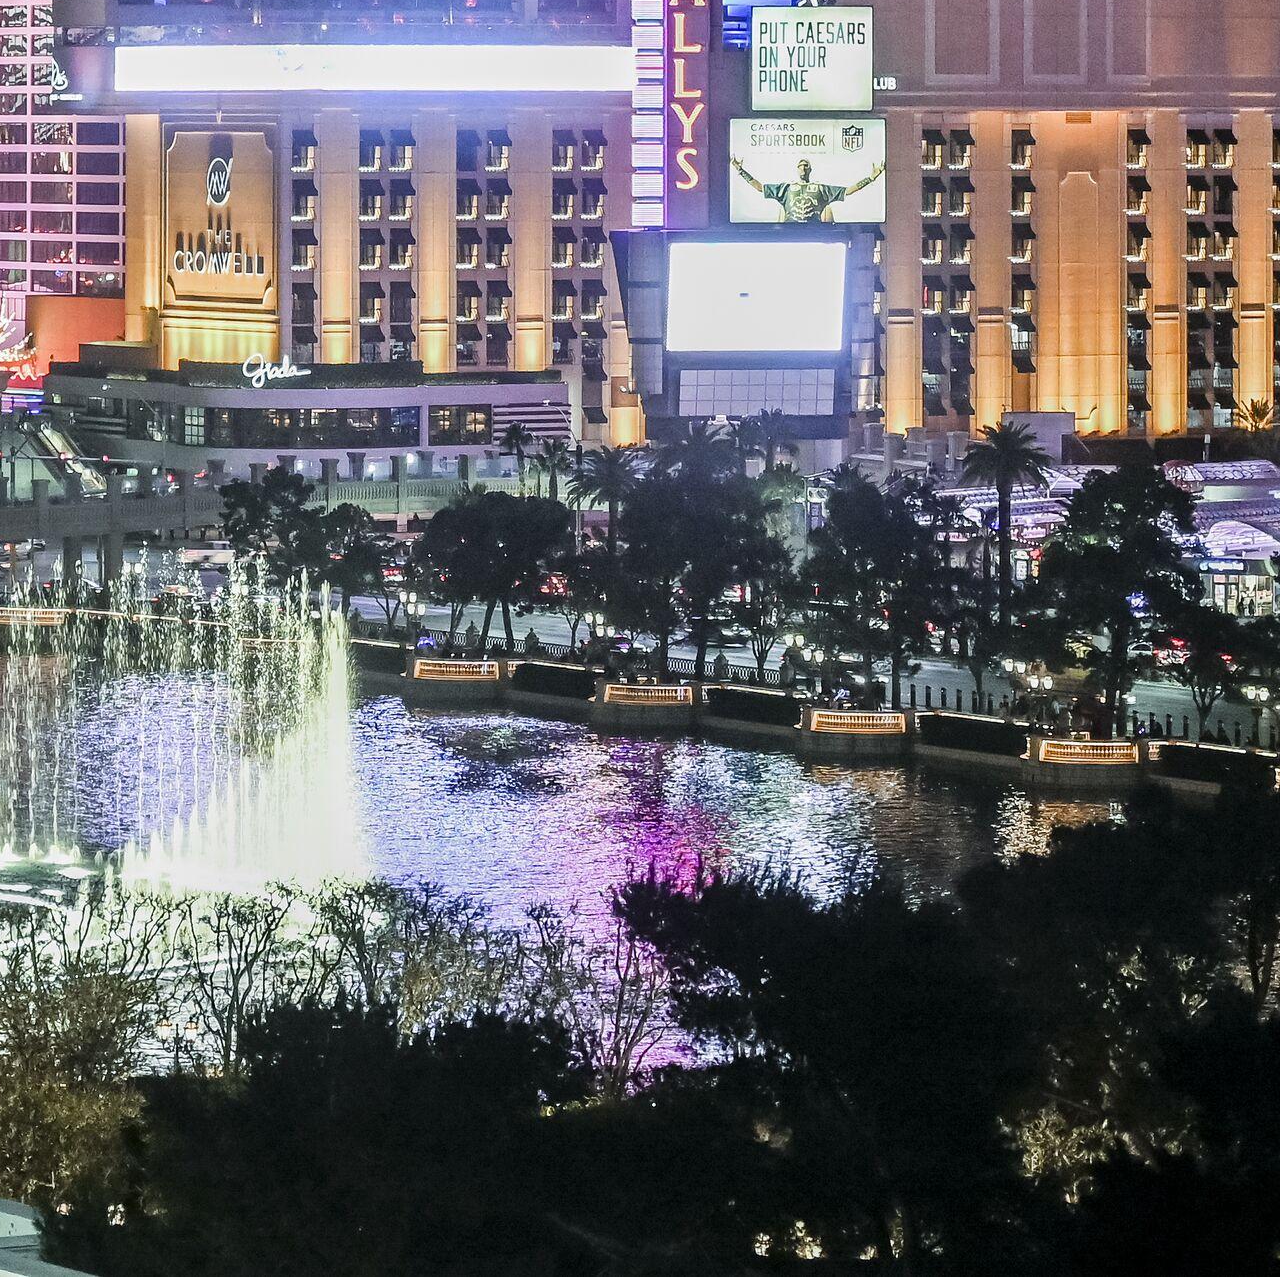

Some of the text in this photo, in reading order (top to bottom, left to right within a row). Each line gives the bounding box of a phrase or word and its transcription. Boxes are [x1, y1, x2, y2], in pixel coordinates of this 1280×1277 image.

[759, 22, 866, 45] PUT CAESARS
[759, 46, 827, 68] ON YOUR
[759, 70, 809, 92] PHONE
[873, 76, 898, 91] LUB
[750, 123, 795, 132] CAESARS
[750, 134, 826, 147] SPORTSBOOK
[844, 135, 862, 149] NFL
[206, 229, 232, 245] THE
[173, 250, 265, 275] CROMWELL
